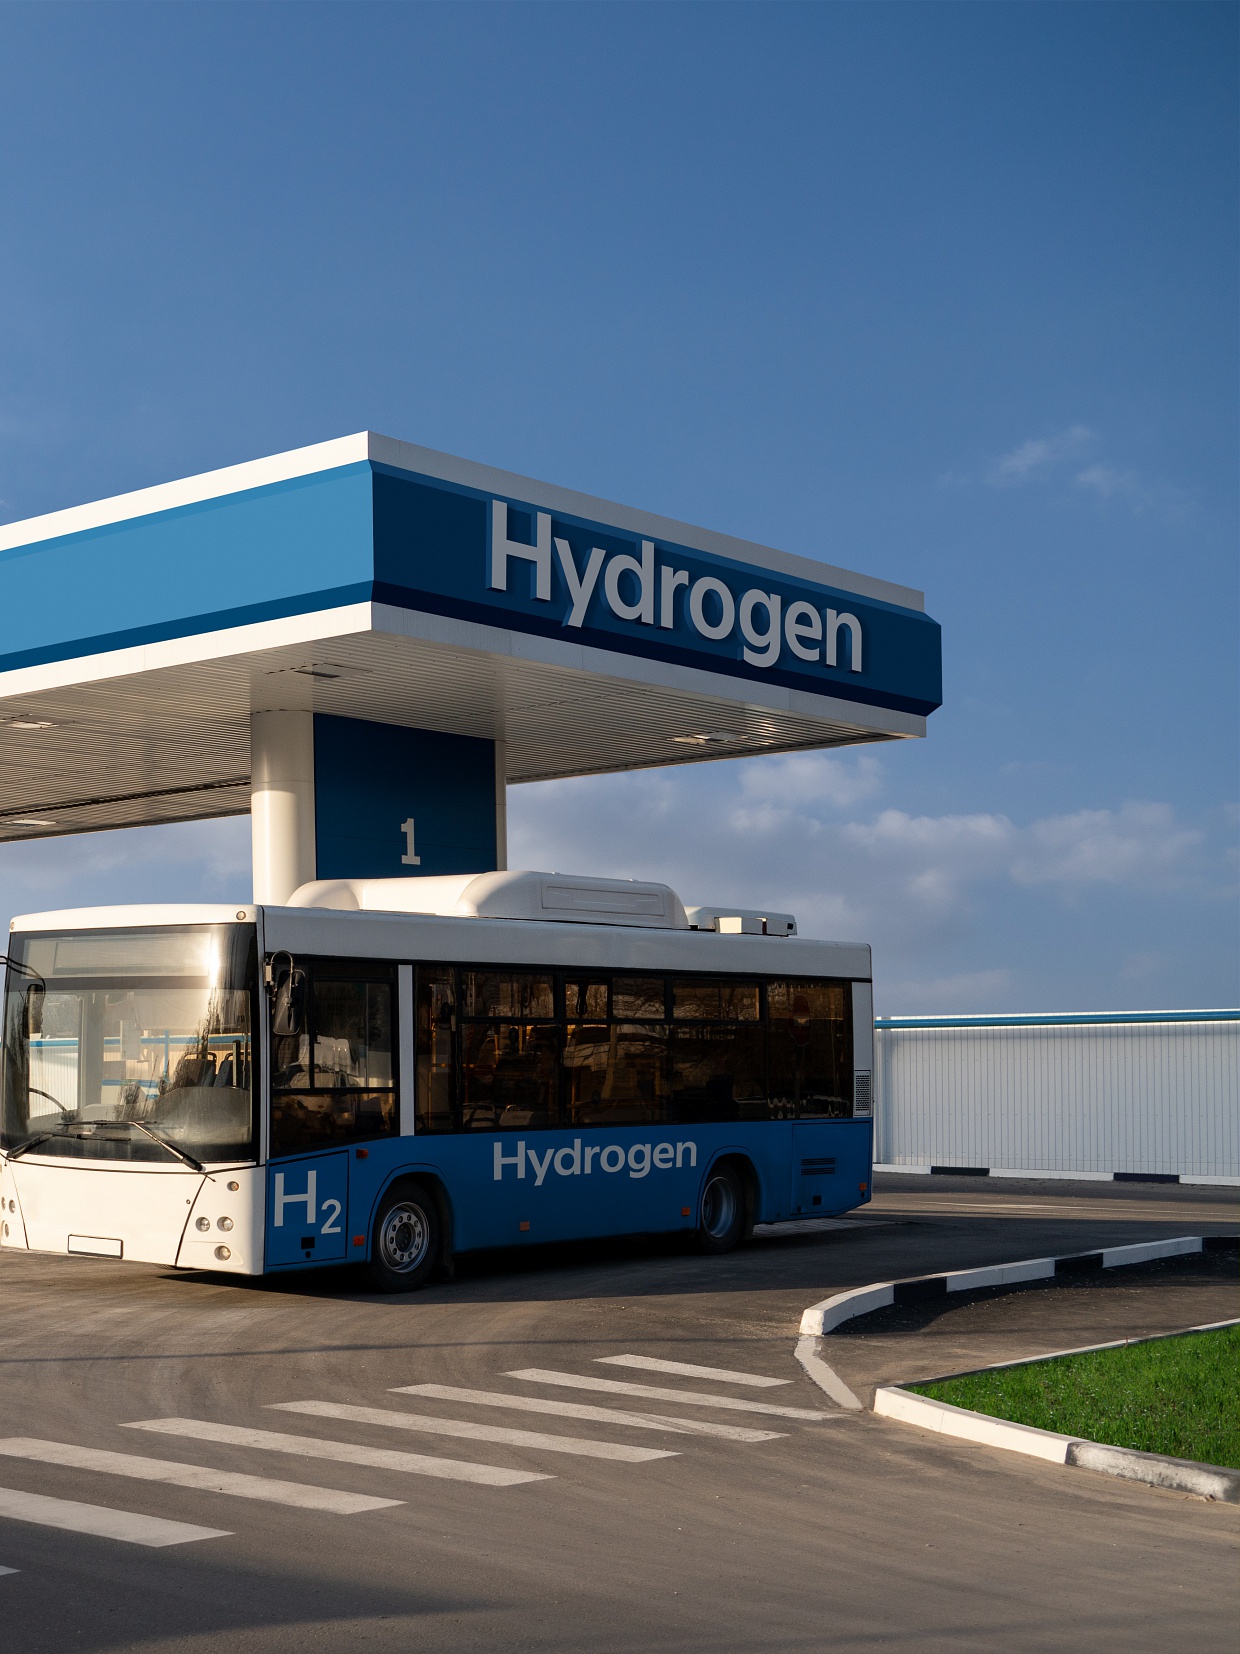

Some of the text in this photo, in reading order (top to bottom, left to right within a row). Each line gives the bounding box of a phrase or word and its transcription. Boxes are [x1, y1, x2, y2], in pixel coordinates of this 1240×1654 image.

[491, 499, 863, 673] Hydrogen
[400, 817, 421, 866] 1
[493, 1138, 698, 1187] Hydrogen
[273, 1169, 342, 1235] H2
